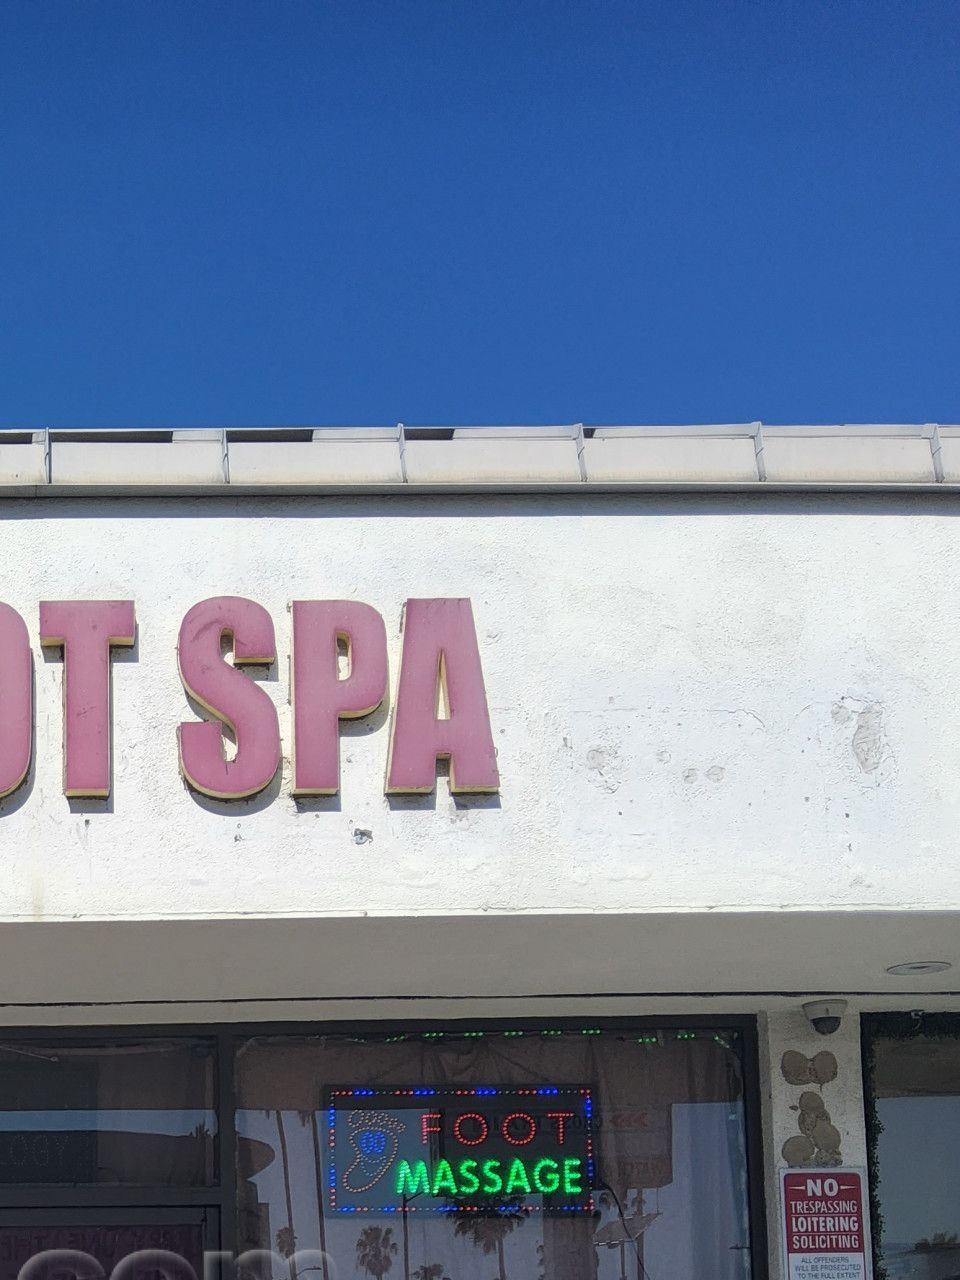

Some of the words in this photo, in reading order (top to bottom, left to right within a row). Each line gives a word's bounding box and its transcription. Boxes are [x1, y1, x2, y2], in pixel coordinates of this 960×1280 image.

[176, 595, 500, 796] SPA
[420, 1112, 576, 1145] FOOT
[396, 1158, 582, 1194] MASSAGE
[807, 1178, 839, 1196] NO
[790, 1201, 857, 1213] TRESPASSING
[792, 1216, 858, 1232] LOITERING
[792, 1234, 859, 1249] SOLICITING
